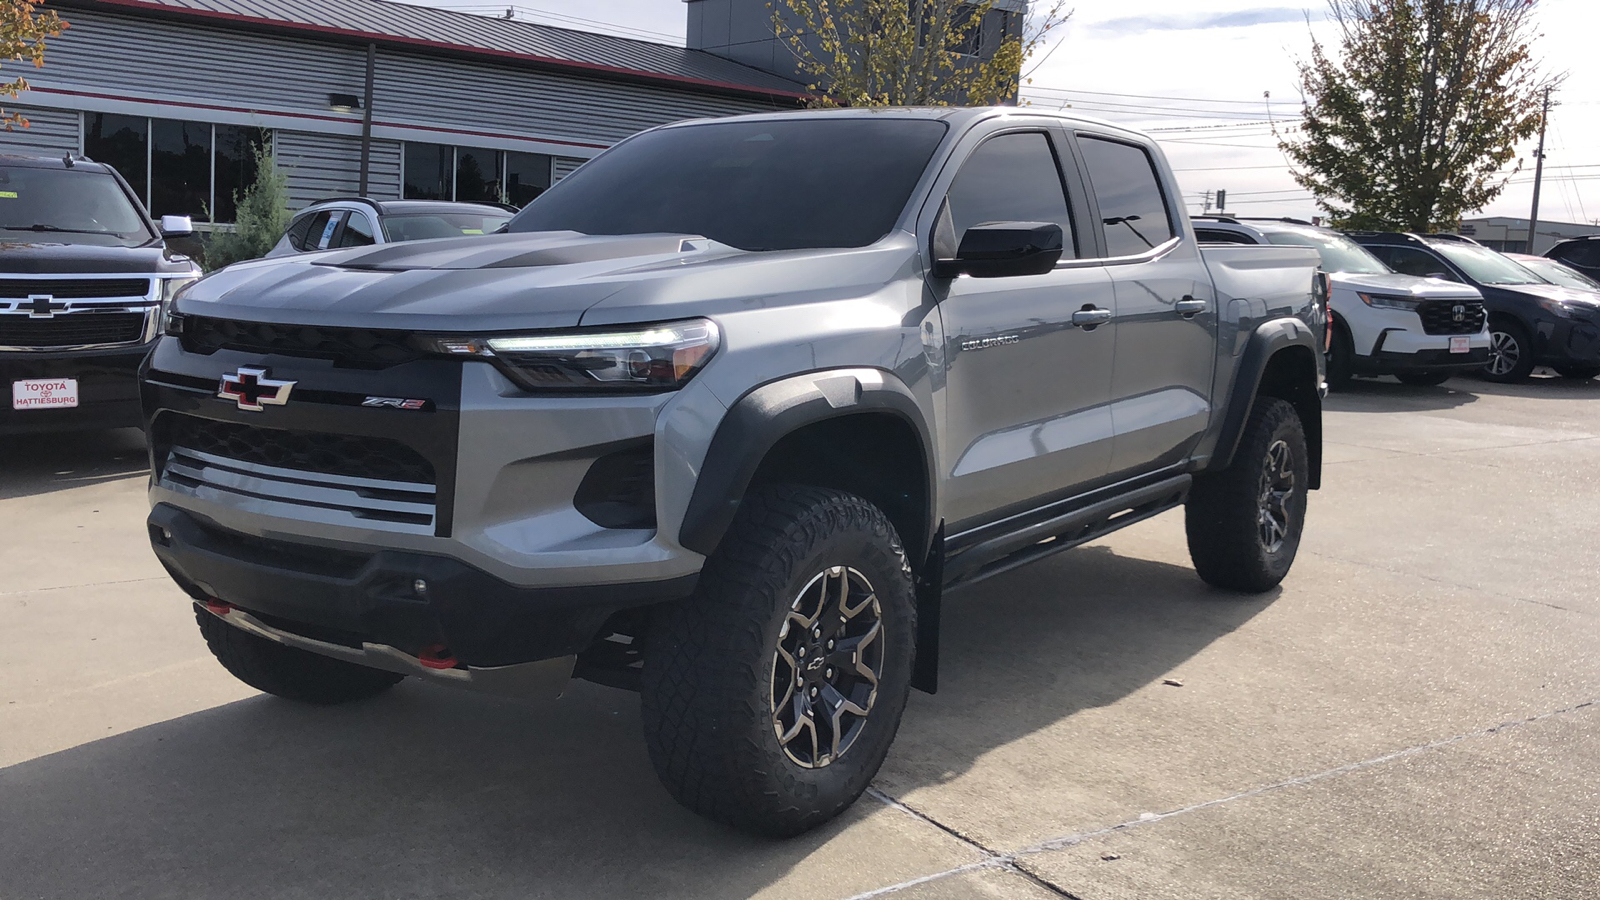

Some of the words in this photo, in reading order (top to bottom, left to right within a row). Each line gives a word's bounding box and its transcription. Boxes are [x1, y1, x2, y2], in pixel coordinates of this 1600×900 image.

[961, 335, 1019, 350] COLORADO
[25, 382, 66, 391] TOYOTA
[16, 397, 75, 405] HATTIESBURG
[361, 396, 426, 409] ZR2
